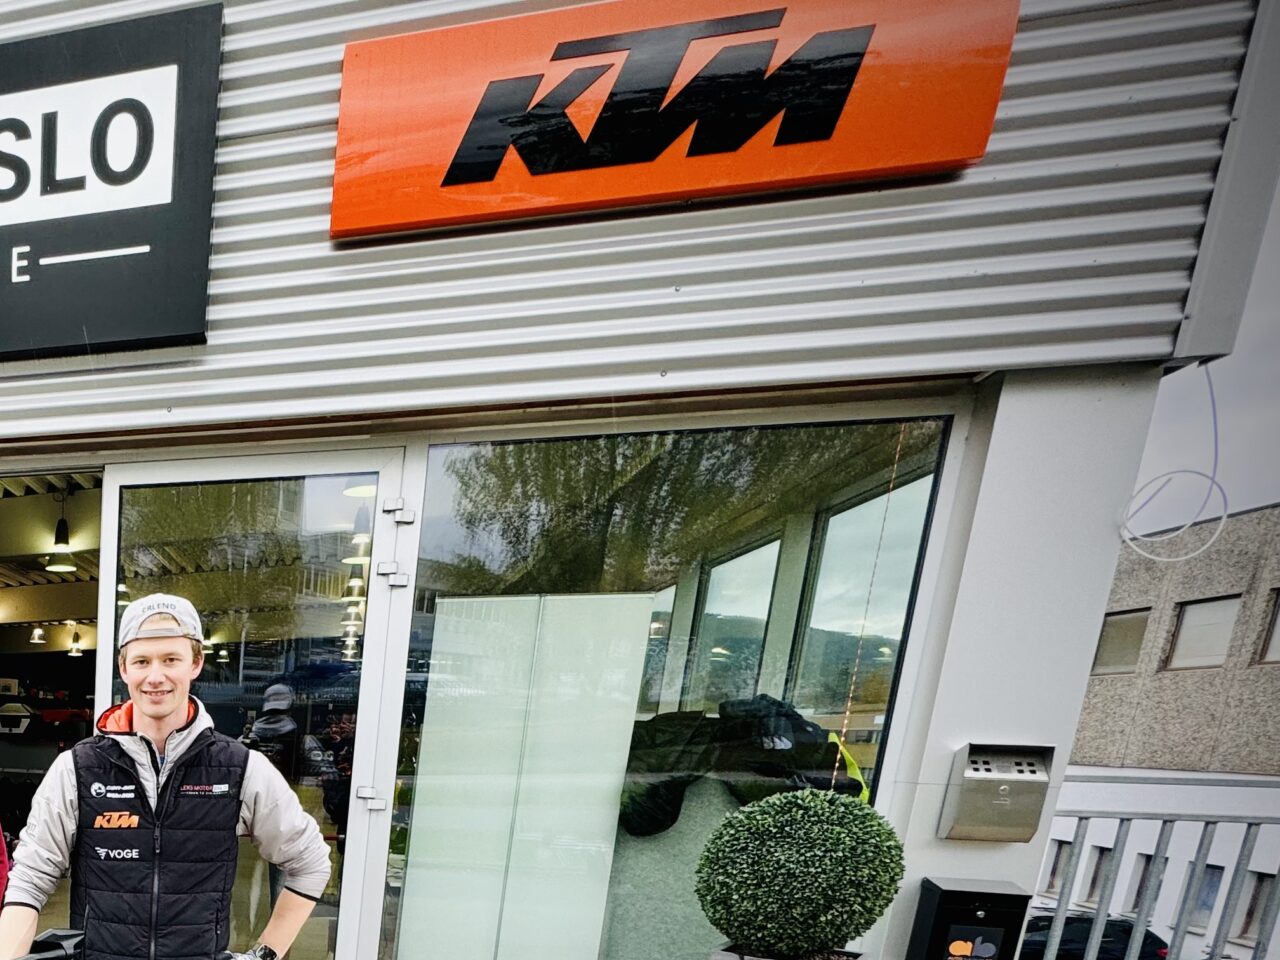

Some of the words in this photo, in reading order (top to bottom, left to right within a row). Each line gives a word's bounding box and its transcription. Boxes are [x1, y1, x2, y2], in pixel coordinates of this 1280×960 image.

[440, 7, 876, 187] KTM
[94, 811, 140, 828] KTM
[108, 849, 139, 859] VOGE
